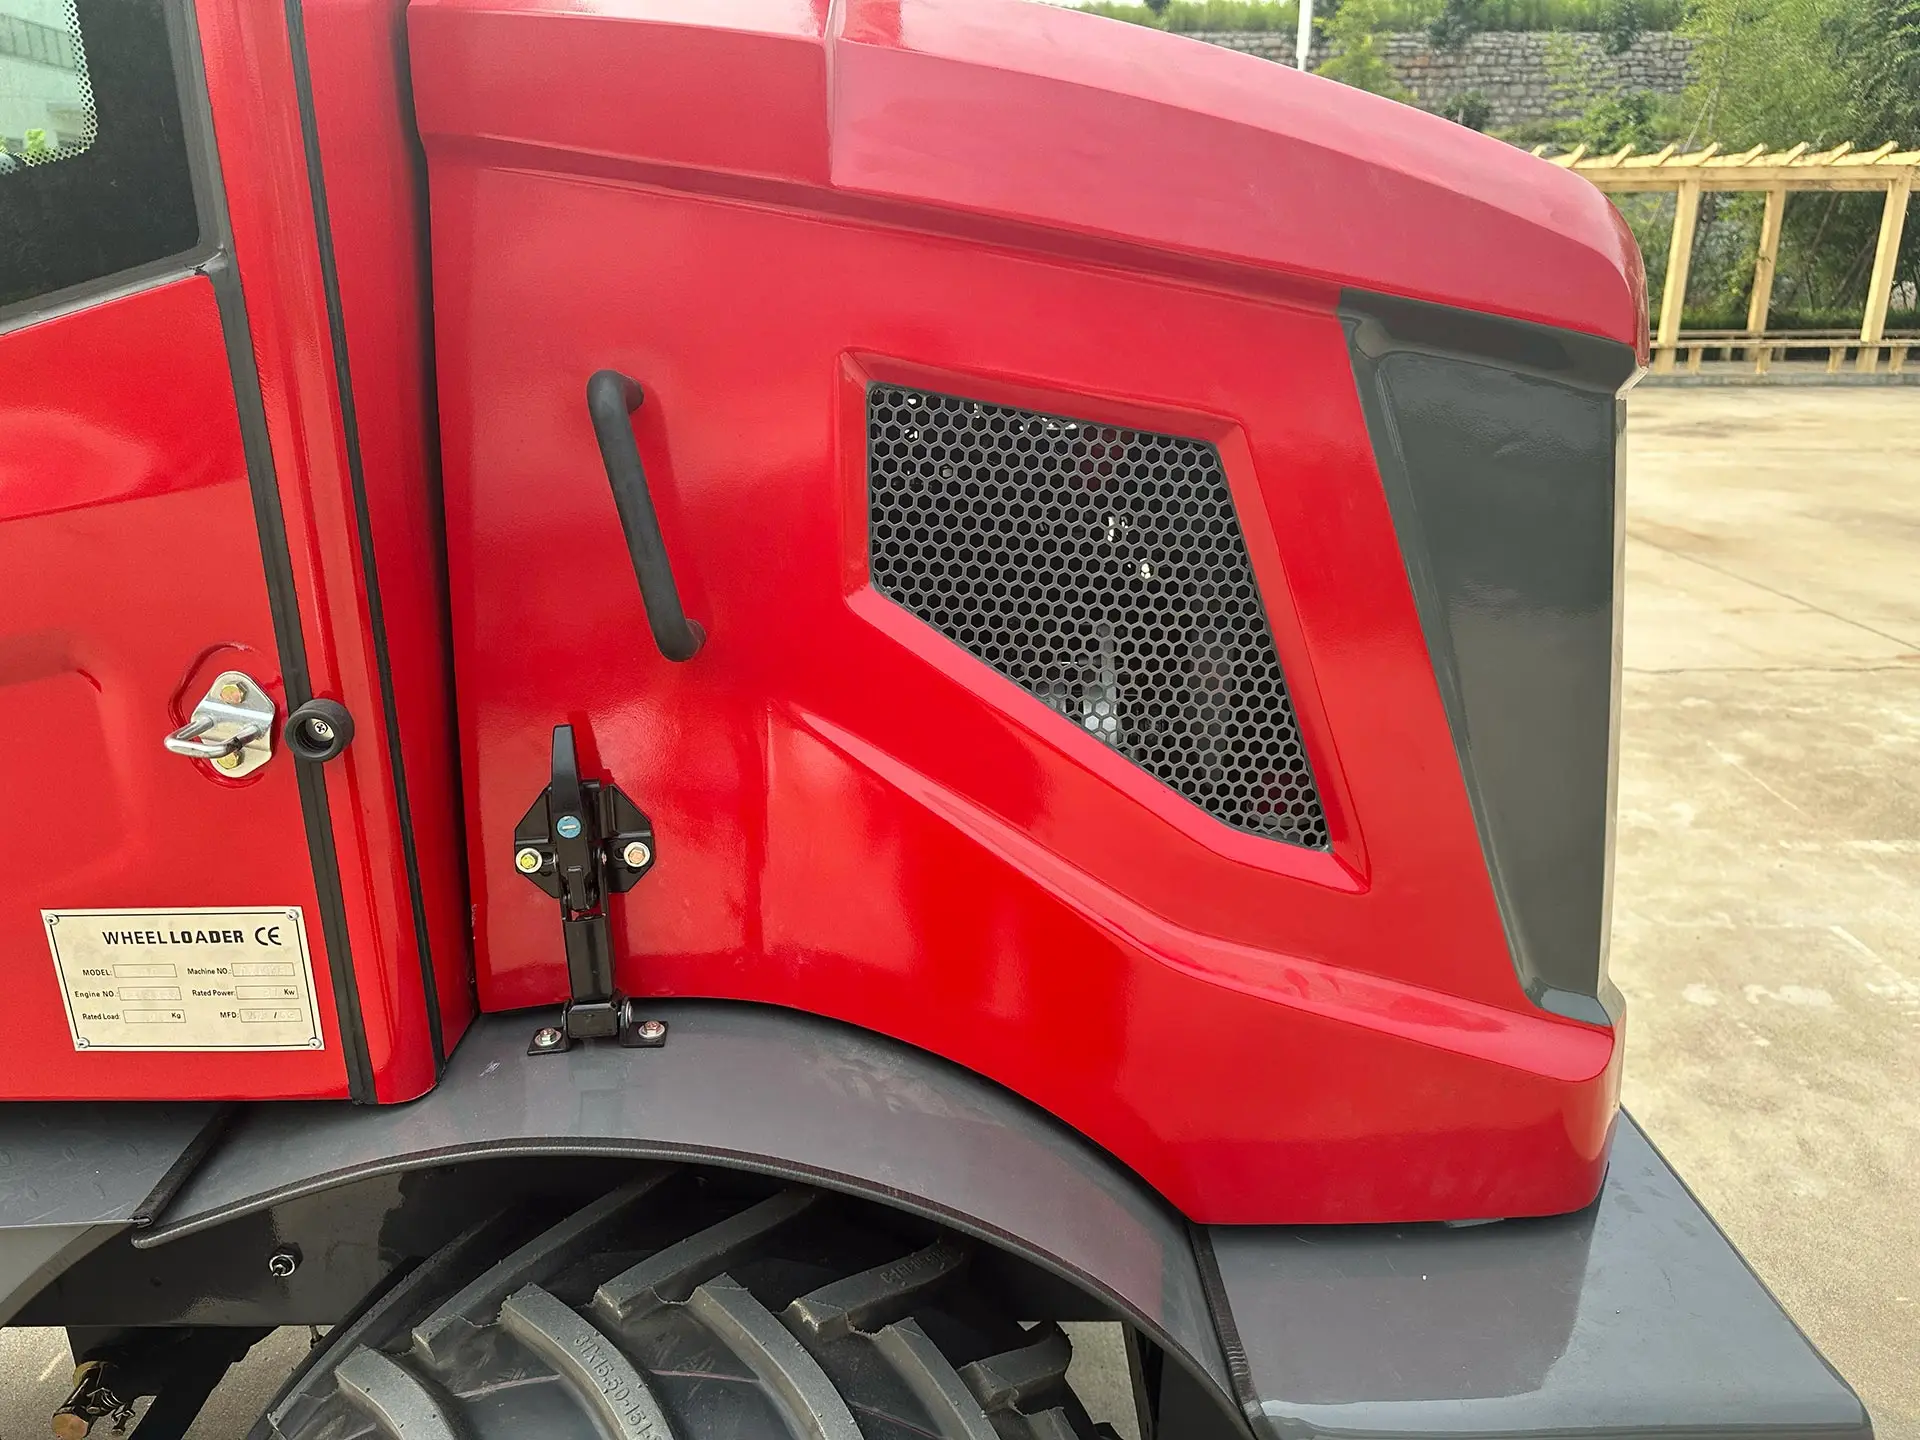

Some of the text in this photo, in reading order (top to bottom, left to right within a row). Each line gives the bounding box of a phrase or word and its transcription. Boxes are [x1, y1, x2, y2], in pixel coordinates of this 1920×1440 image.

[102, 926, 282, 946] WHEEL LOADER CE
